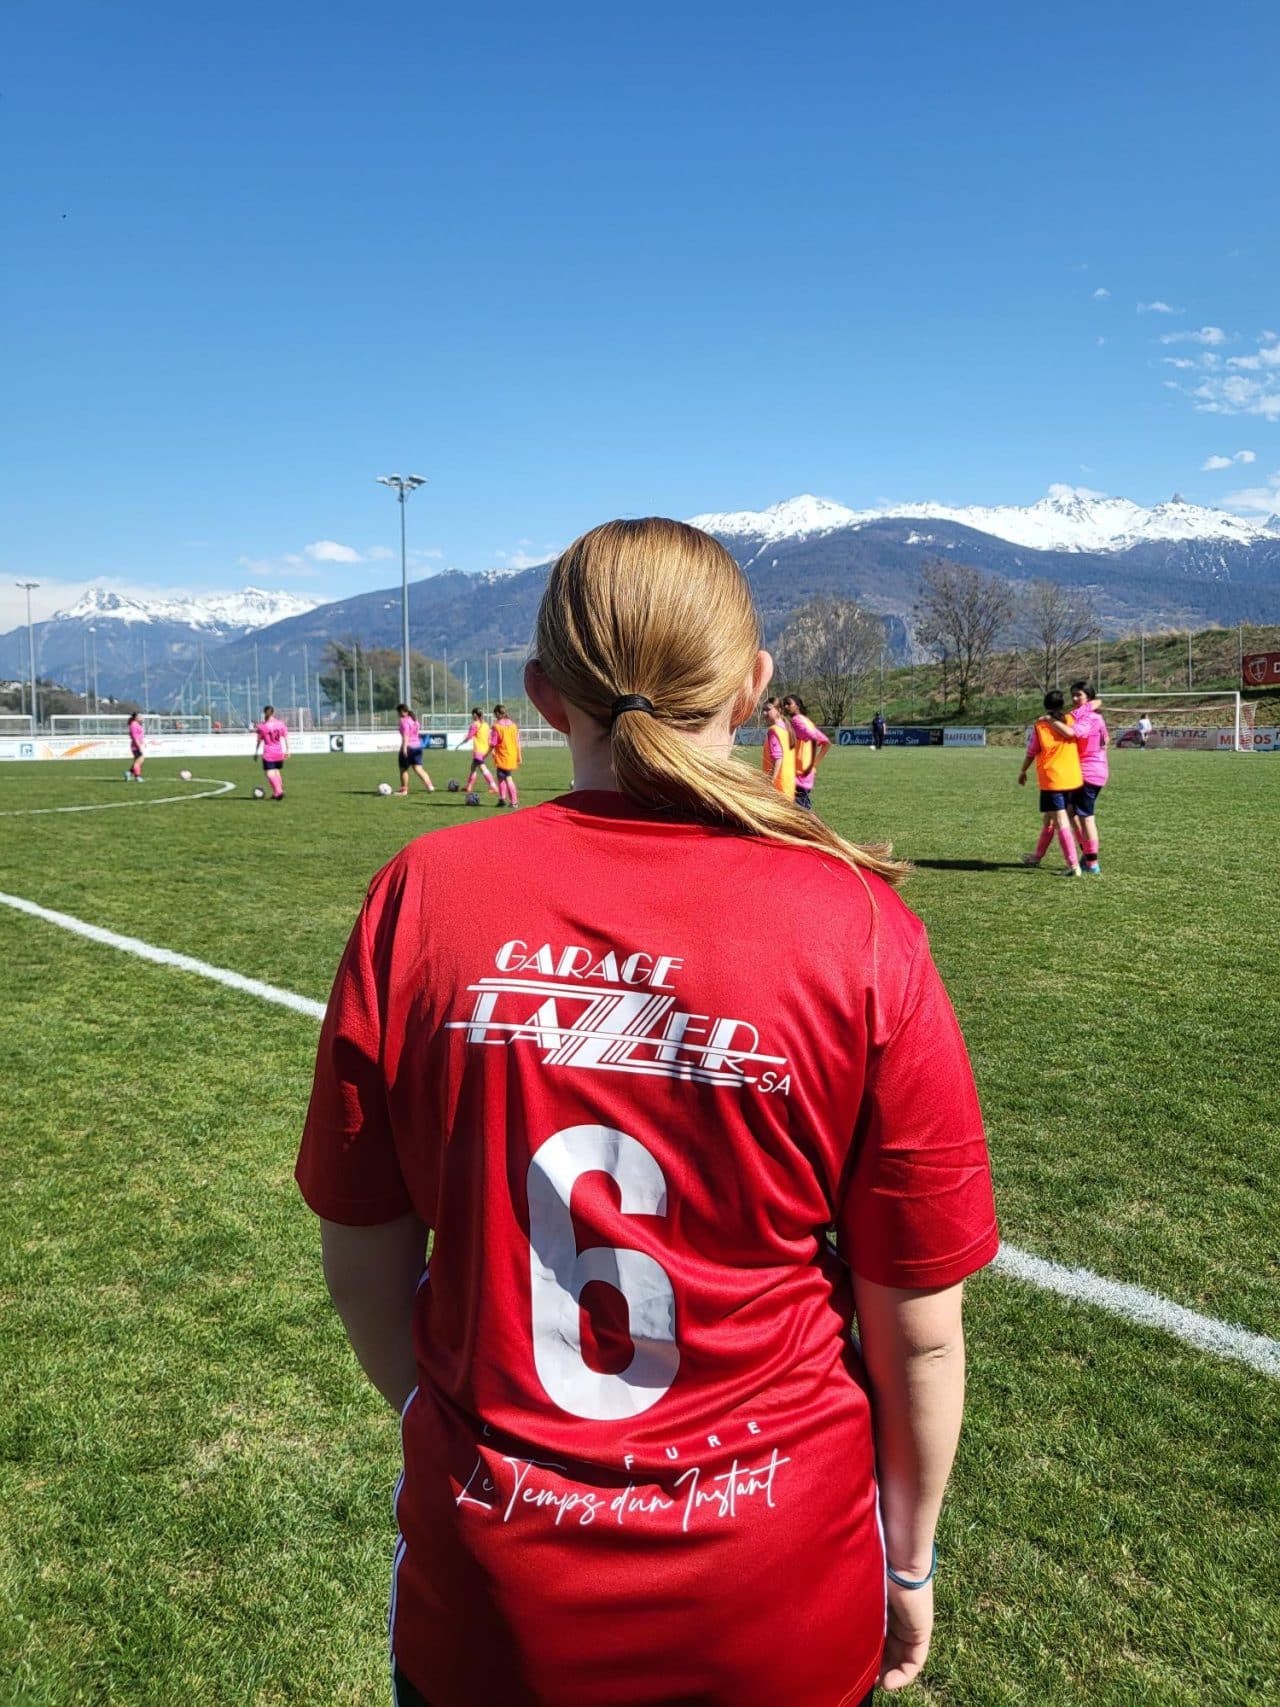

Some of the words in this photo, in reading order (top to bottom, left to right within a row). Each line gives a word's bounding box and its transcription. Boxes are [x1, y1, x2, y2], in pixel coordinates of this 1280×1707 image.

[495, 939, 685, 989] GARAGE
[462, 978, 761, 1087] LAZER
[757, 1071, 792, 1097] SA
[526, 1124, 681, 1421] 6
[455, 1453, 495, 1511] Le
[502, 1456, 606, 1526] Temps
[673, 1447, 792, 1532] Instant
